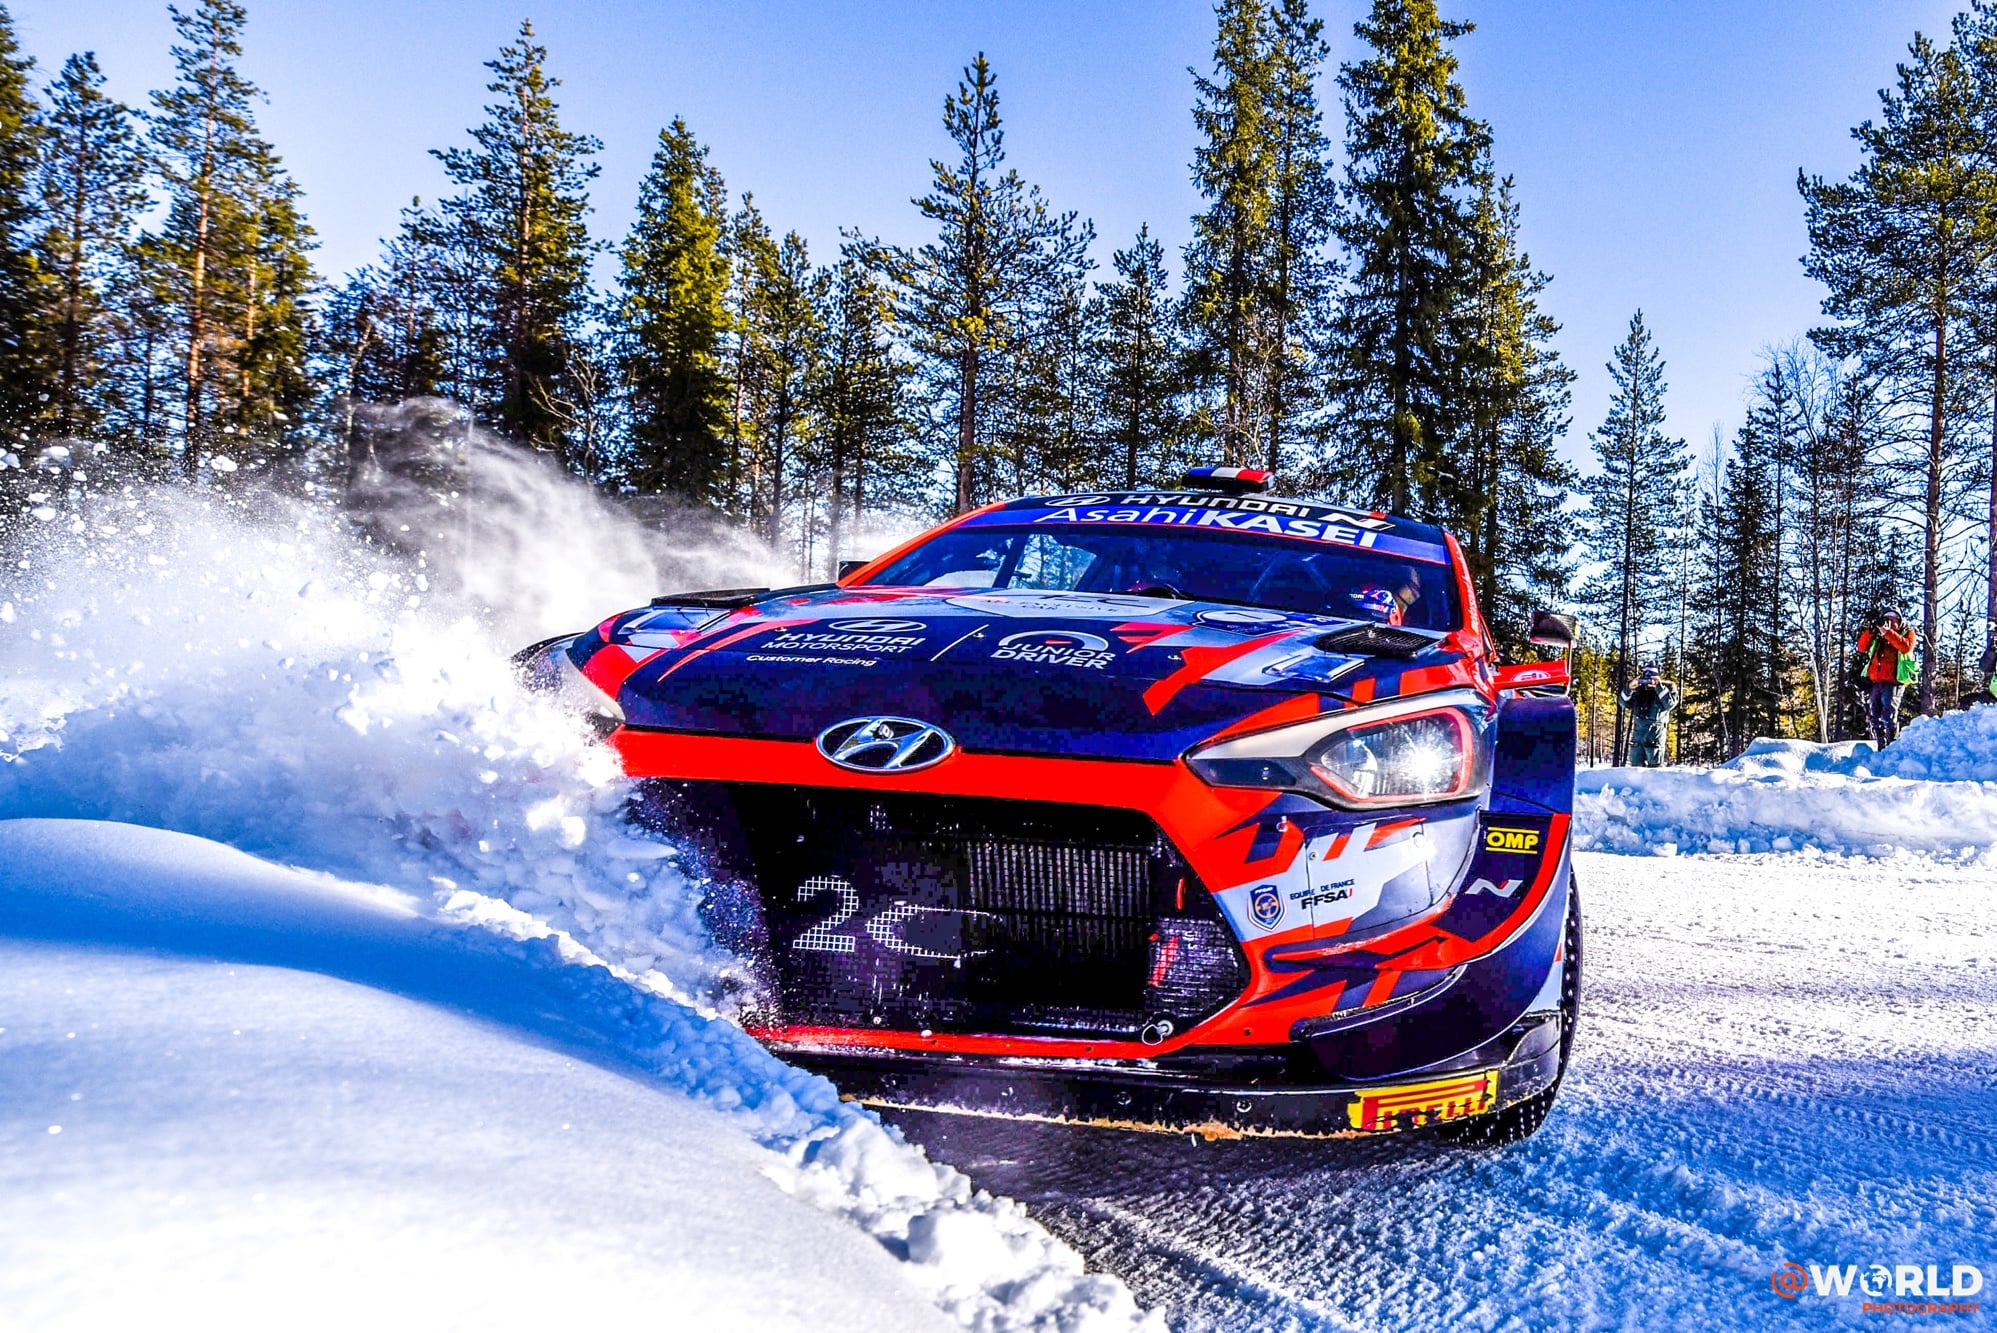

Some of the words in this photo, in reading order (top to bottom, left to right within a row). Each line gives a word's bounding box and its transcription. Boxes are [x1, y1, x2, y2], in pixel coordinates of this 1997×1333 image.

[1120, 495, 1311, 518] HYUNDAI
[1032, 507, 1378, 548] AsahiKASEI
[761, 641, 913, 653] MOTORSPORT
[775, 633, 926, 645] HYUNDAI
[746, 654, 822, 663] Customer
[823, 656, 877, 667] Racing
[990, 649, 1107, 669] DRIVER
[1002, 643, 1116, 661] JUNIOR
[1486, 831, 1539, 849] OMP
[1320, 883, 1329, 892] DE
[1330, 878, 1355, 891] FRANCE
[1301, 889, 1348, 910] FFSA
